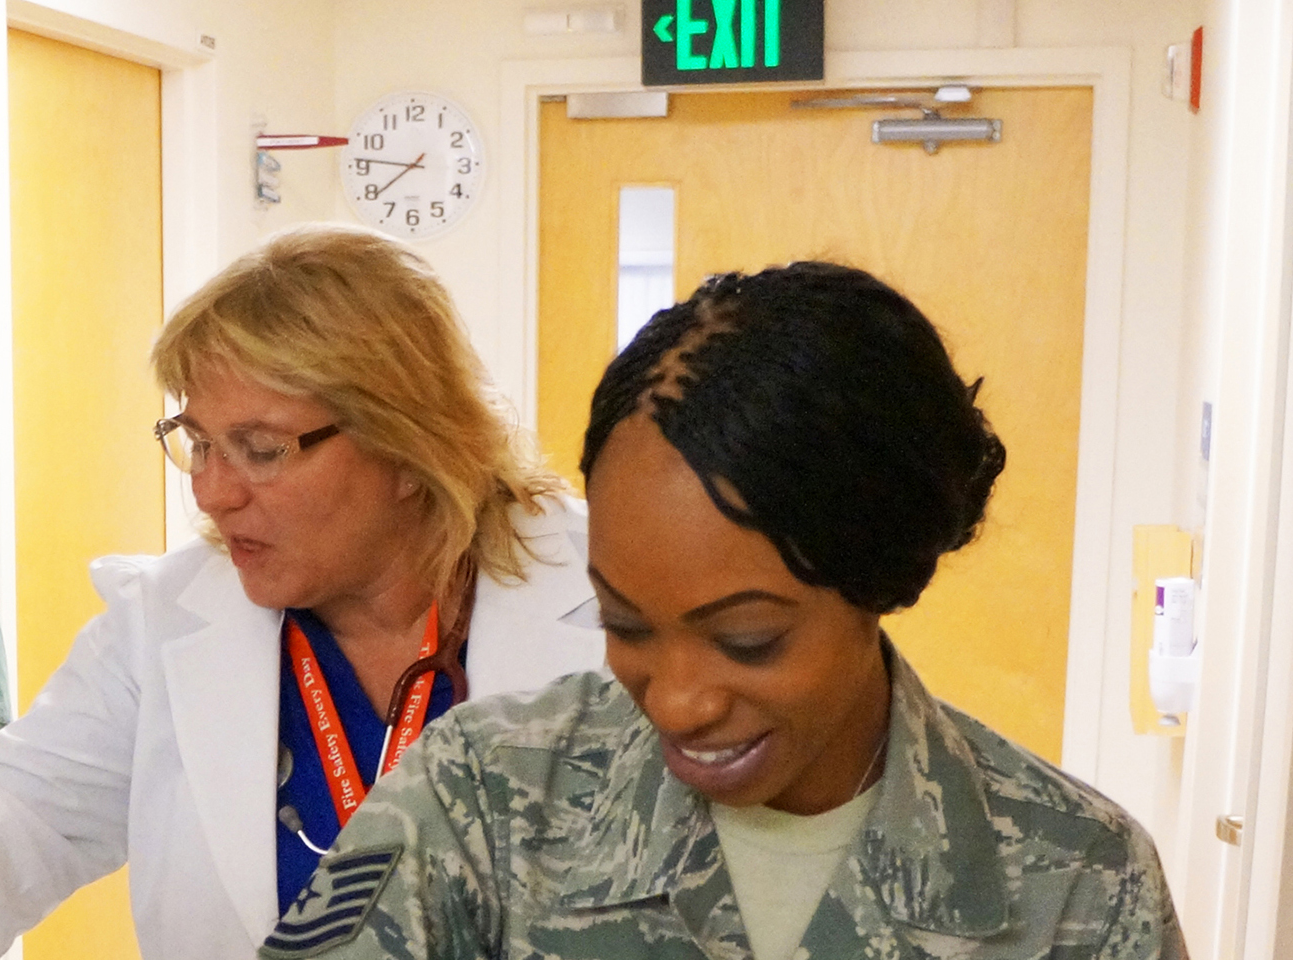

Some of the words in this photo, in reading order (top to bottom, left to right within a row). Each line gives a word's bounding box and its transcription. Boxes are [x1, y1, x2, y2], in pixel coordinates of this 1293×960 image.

[405, 105, 425, 122] 12
[364, 133, 384, 151] 10
[450, 131, 464, 149] 2
[457, 157, 472, 175] 3
[364, 184, 379, 201] 8
[450, 183, 463, 199] 4
[383, 202, 396, 218] 7
[405, 209, 420, 226] 6
[430, 201, 445, 218] 5
[301, 657, 315, 688] Day
[311, 690, 330, 731] Every
[405, 694, 422, 723] Fire
[327, 733, 347, 778] Safety
[341, 779, 357, 810] Fire
